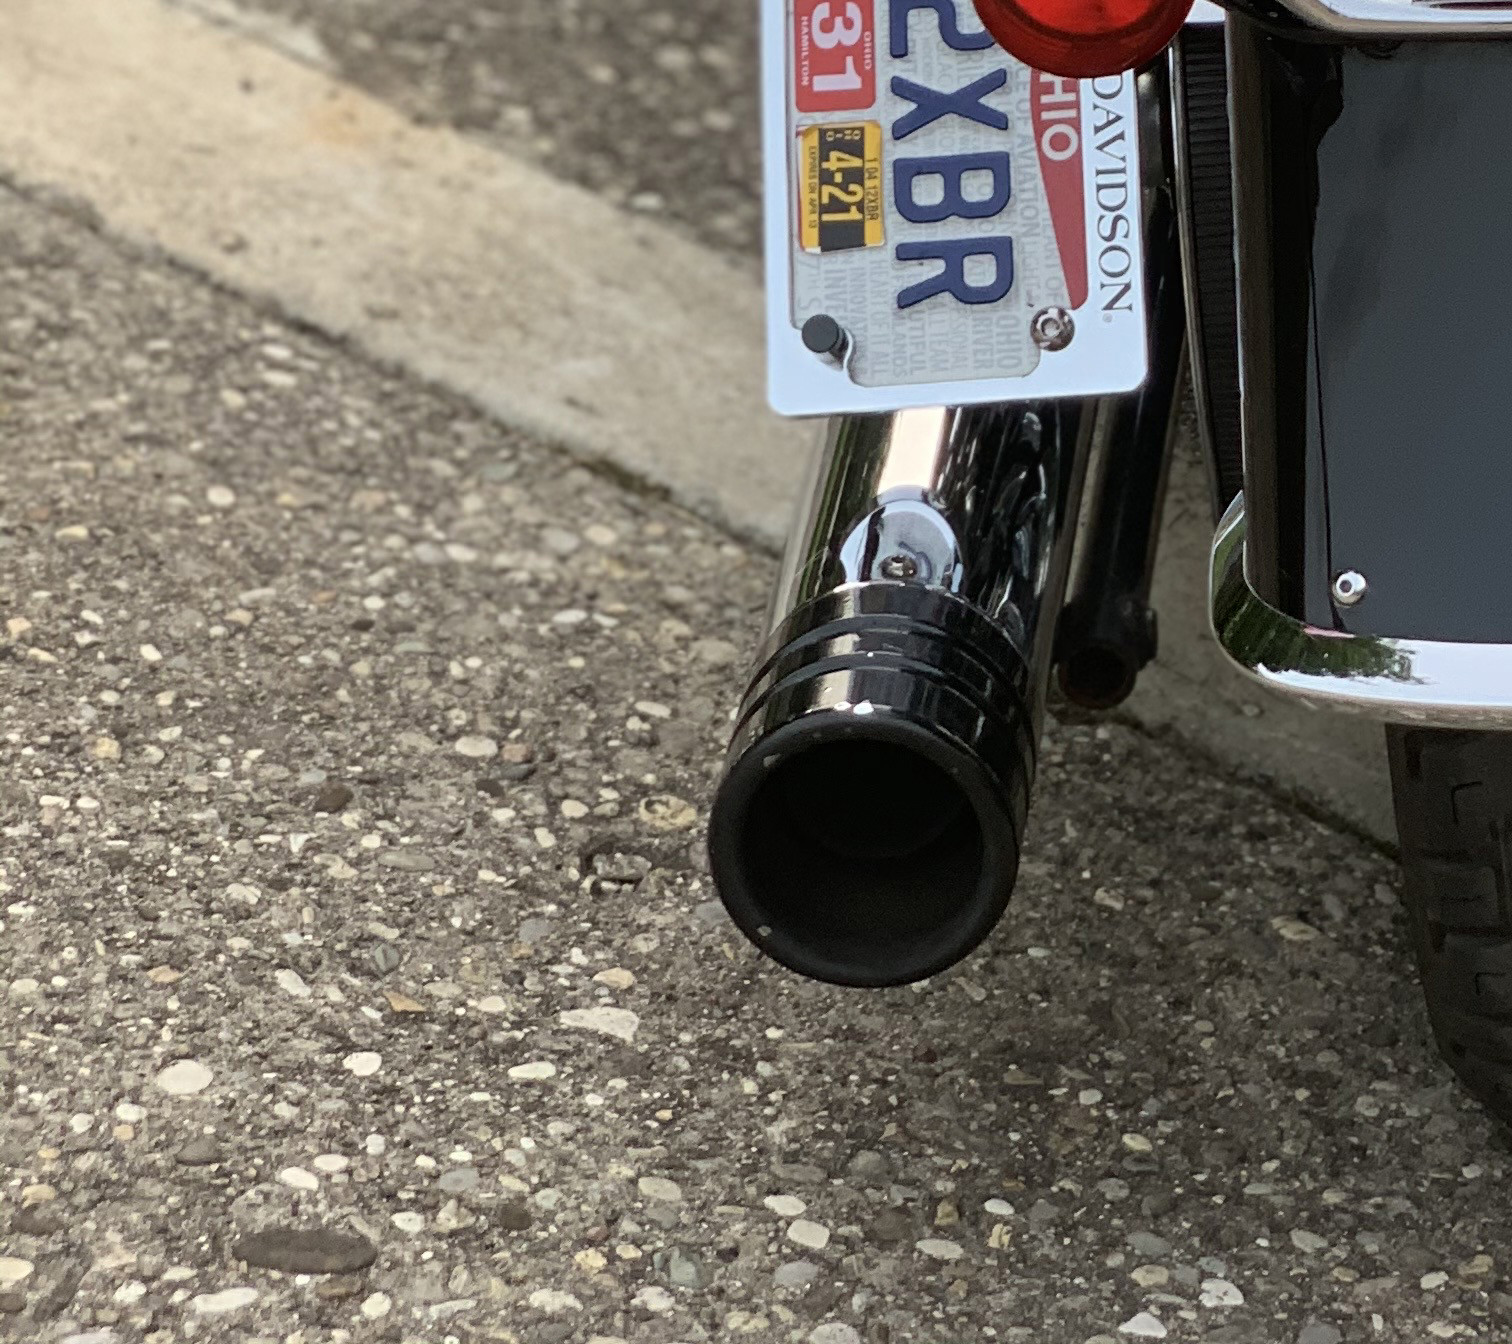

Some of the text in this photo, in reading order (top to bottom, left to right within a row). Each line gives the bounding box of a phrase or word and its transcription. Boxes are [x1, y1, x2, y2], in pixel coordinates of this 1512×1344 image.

[800, 15, 810, 87] HAMILTON
[811, 1, 863, 93] 31
[863, 30, 872, 70] OHIO
[1039, 72, 1080, 162] HIO
[821, 150, 863, 222] 4-21
[1092, 74, 1134, 314] DAVIDSON
